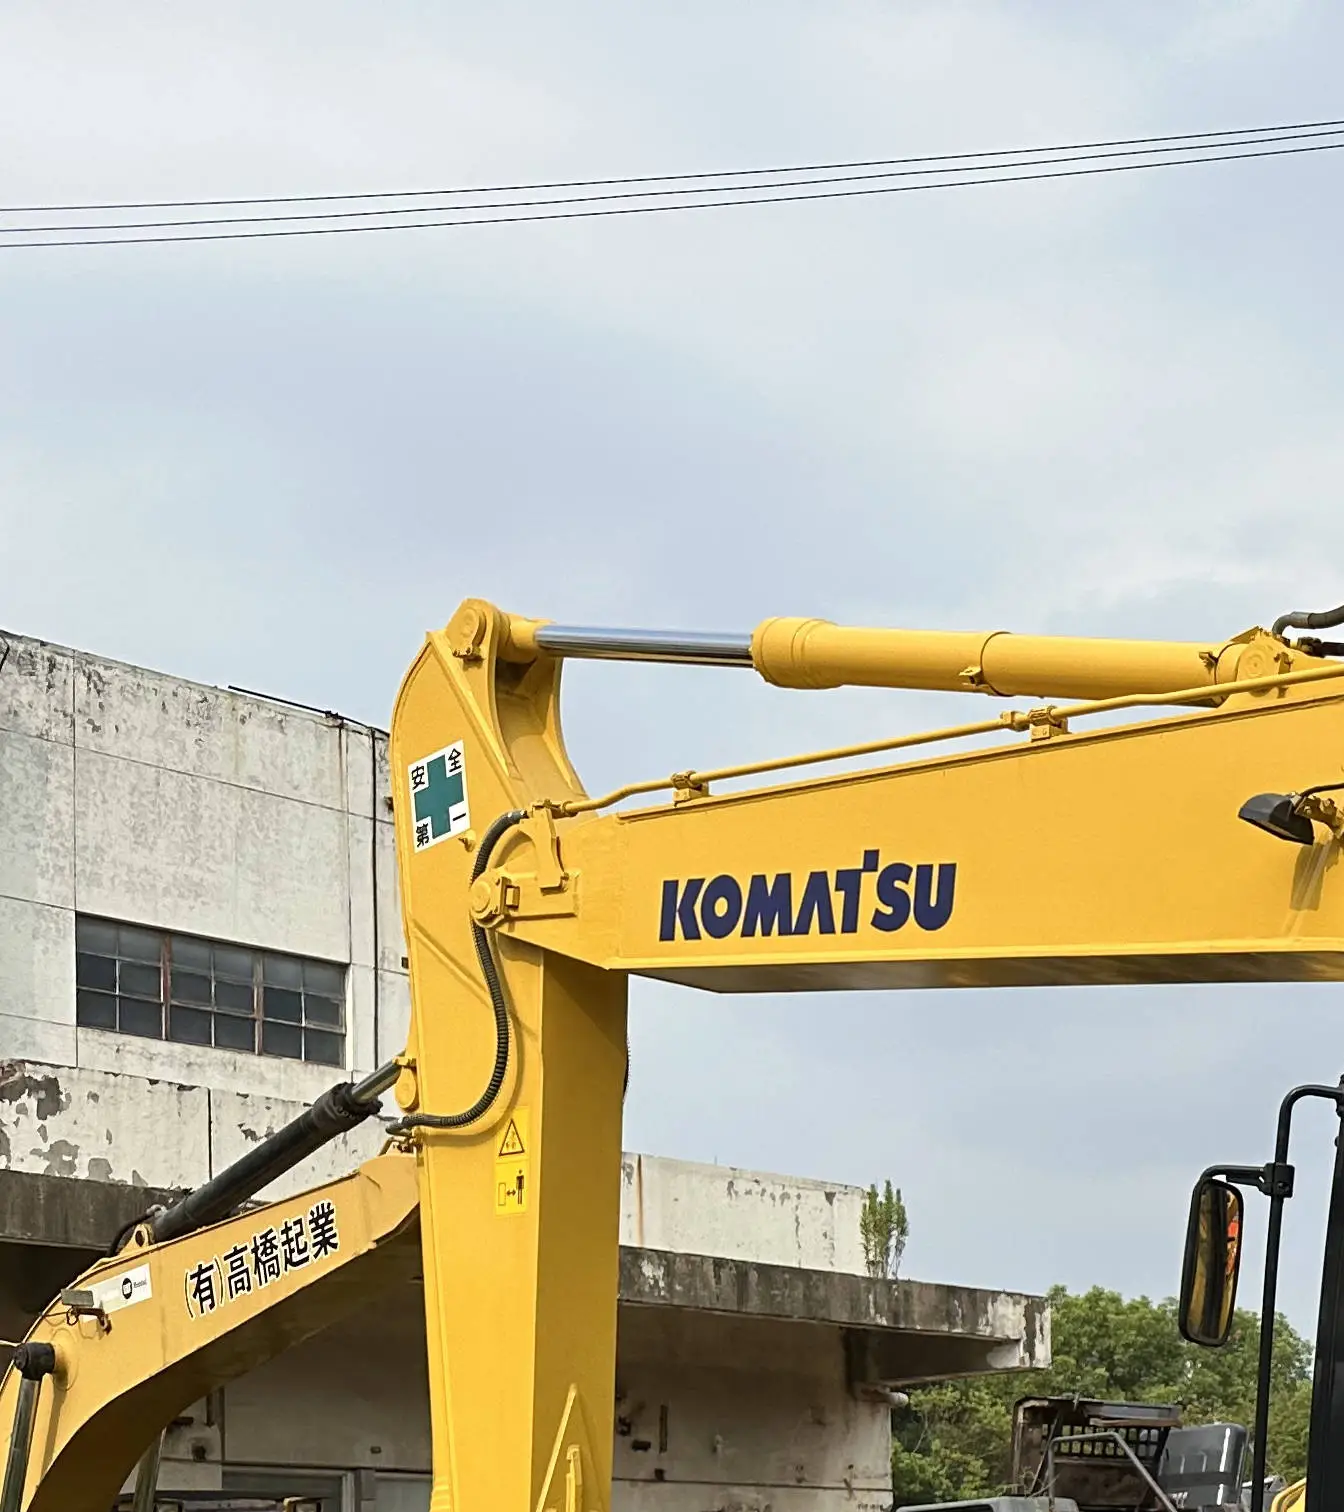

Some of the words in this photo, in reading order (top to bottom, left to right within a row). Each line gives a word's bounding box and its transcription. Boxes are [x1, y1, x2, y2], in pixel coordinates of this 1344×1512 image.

[659, 848, 957, 942] KOMATSU
[185, 1201, 339, 1318] (有)高橋起業
